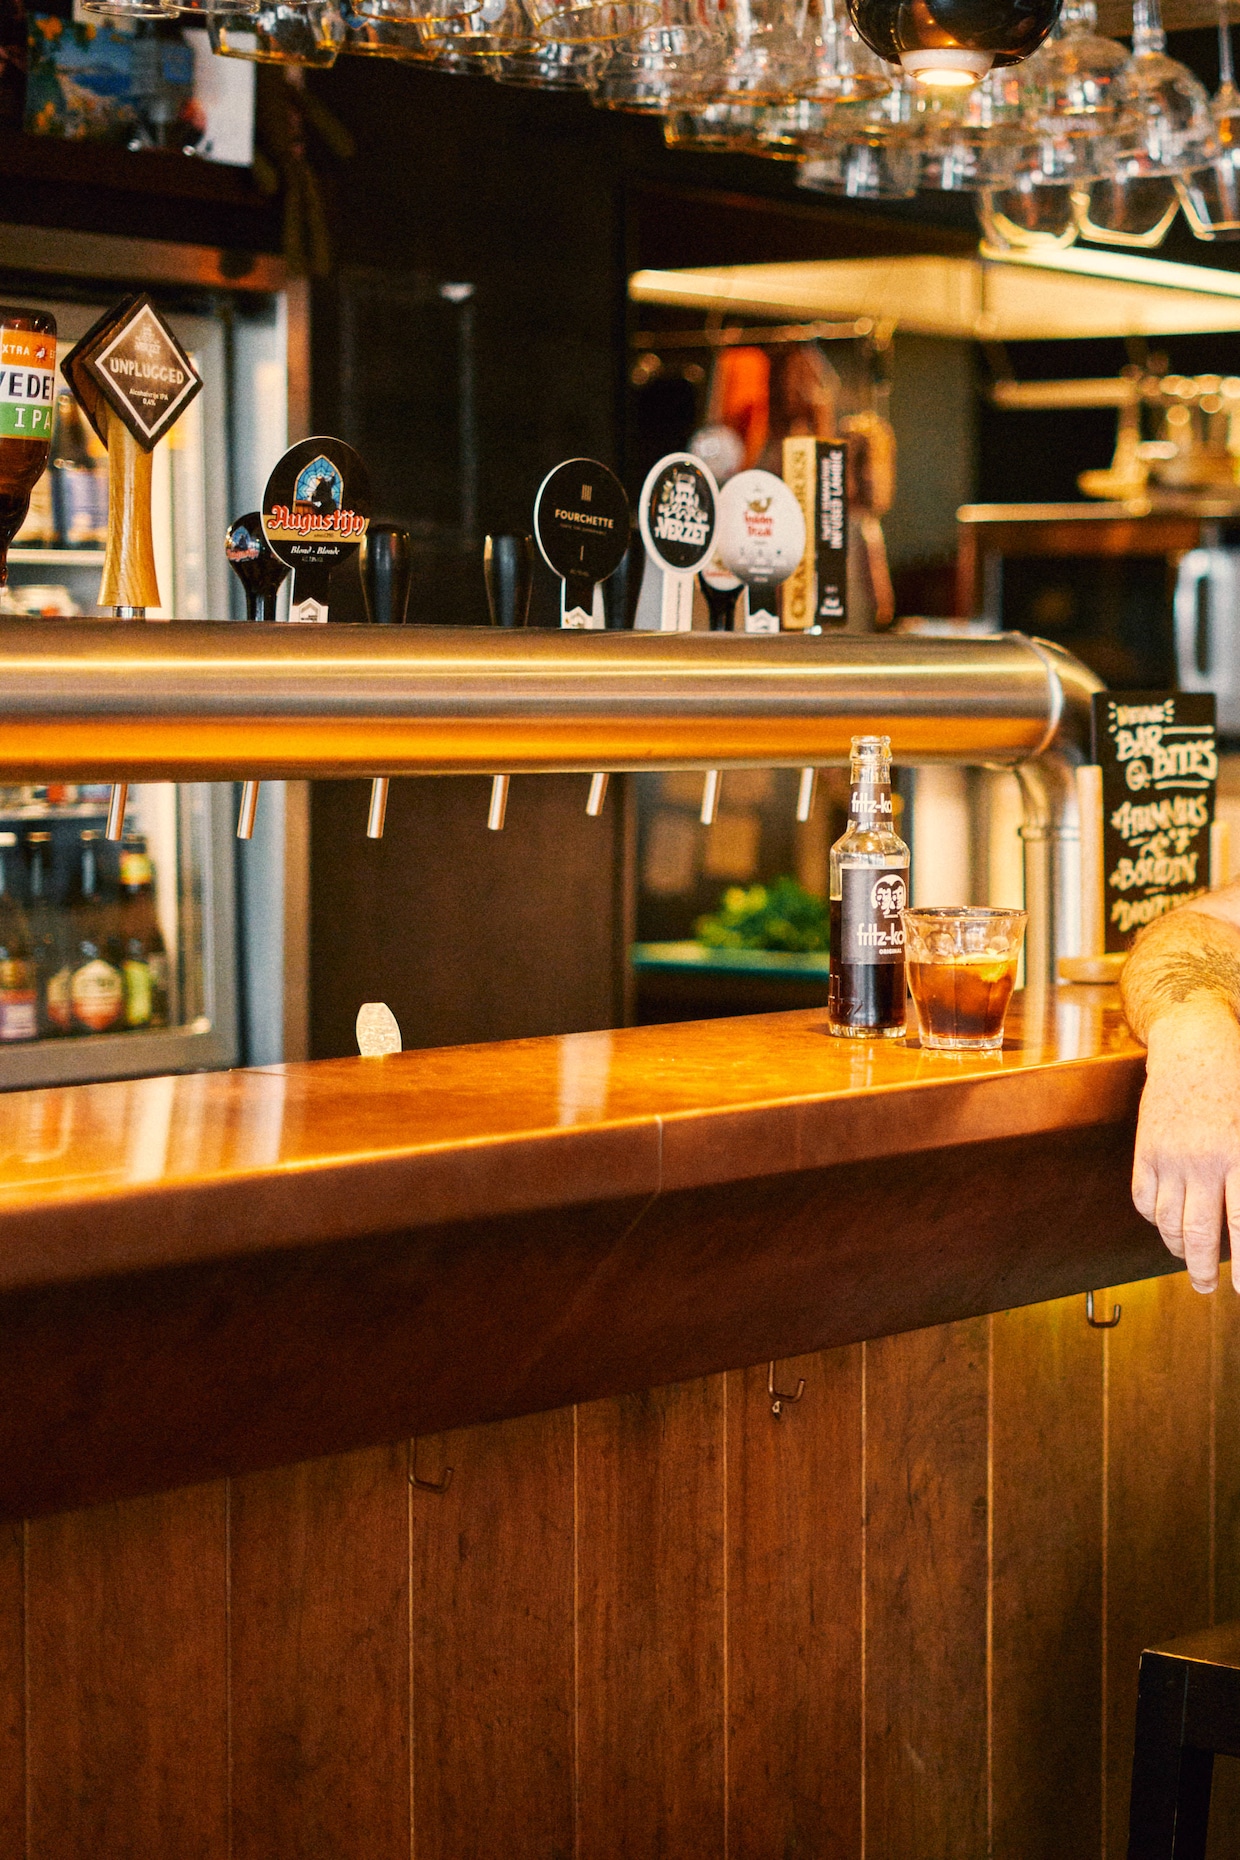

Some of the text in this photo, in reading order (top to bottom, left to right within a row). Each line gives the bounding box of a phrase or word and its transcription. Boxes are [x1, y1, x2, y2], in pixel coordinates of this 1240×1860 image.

[109, 357, 184, 385] UNPLUGGED
[14, 407, 52, 430] IPA
[267, 504, 366, 537] Augustijn
[555, 508, 614, 529] FOURCHETTE
[1114, 725, 1163, 761] BAR
[1151, 739, 1218, 781] BITES
